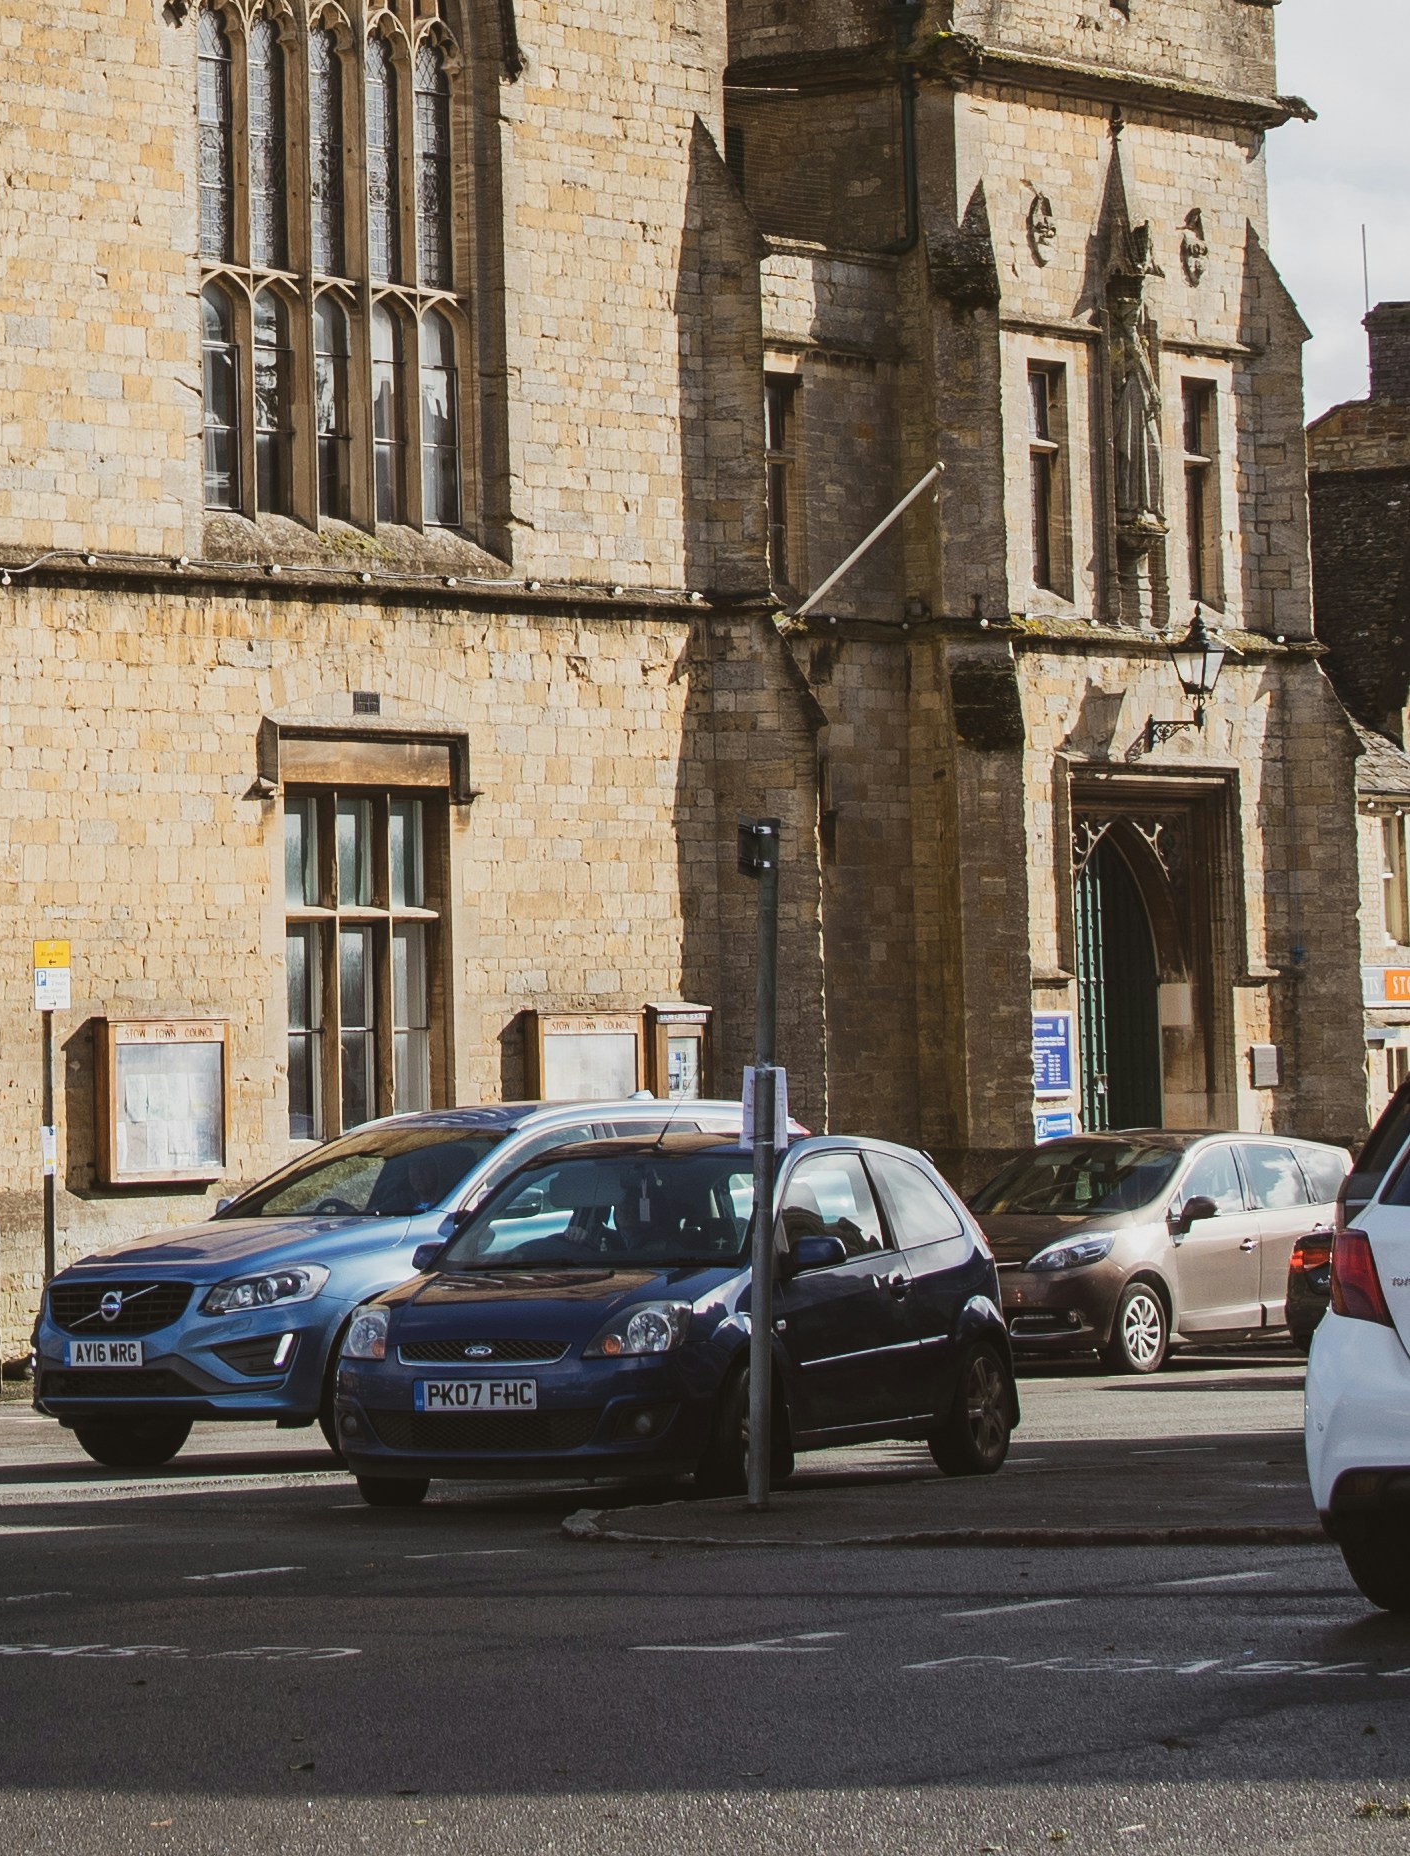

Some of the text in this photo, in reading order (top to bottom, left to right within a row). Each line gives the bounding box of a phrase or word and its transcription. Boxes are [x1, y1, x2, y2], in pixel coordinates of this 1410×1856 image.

[125, 1027, 215, 1039] STOW TOWN COUNCIL
[75, 1343, 137, 1363] AY16 WRG
[427, 1382, 533, 1407] PK07 FHC
